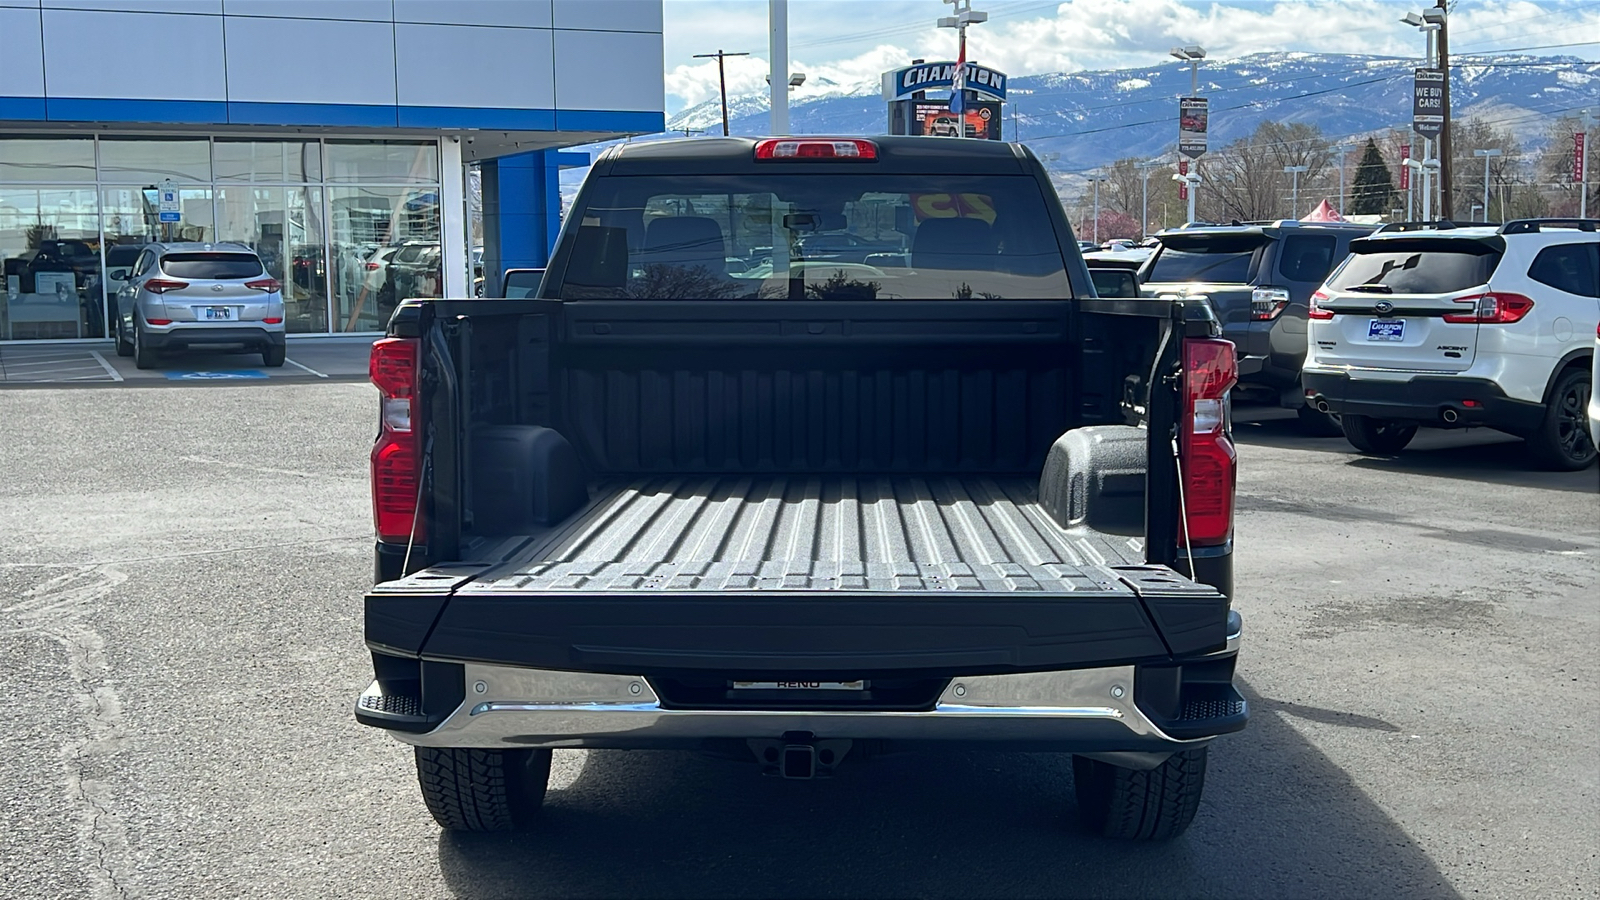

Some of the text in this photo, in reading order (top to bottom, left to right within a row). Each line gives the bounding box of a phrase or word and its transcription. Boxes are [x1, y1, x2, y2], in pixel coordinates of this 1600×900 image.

[1416, 87, 1443, 98] WE BUY
[1418, 98, 1441, 108] CARS!
